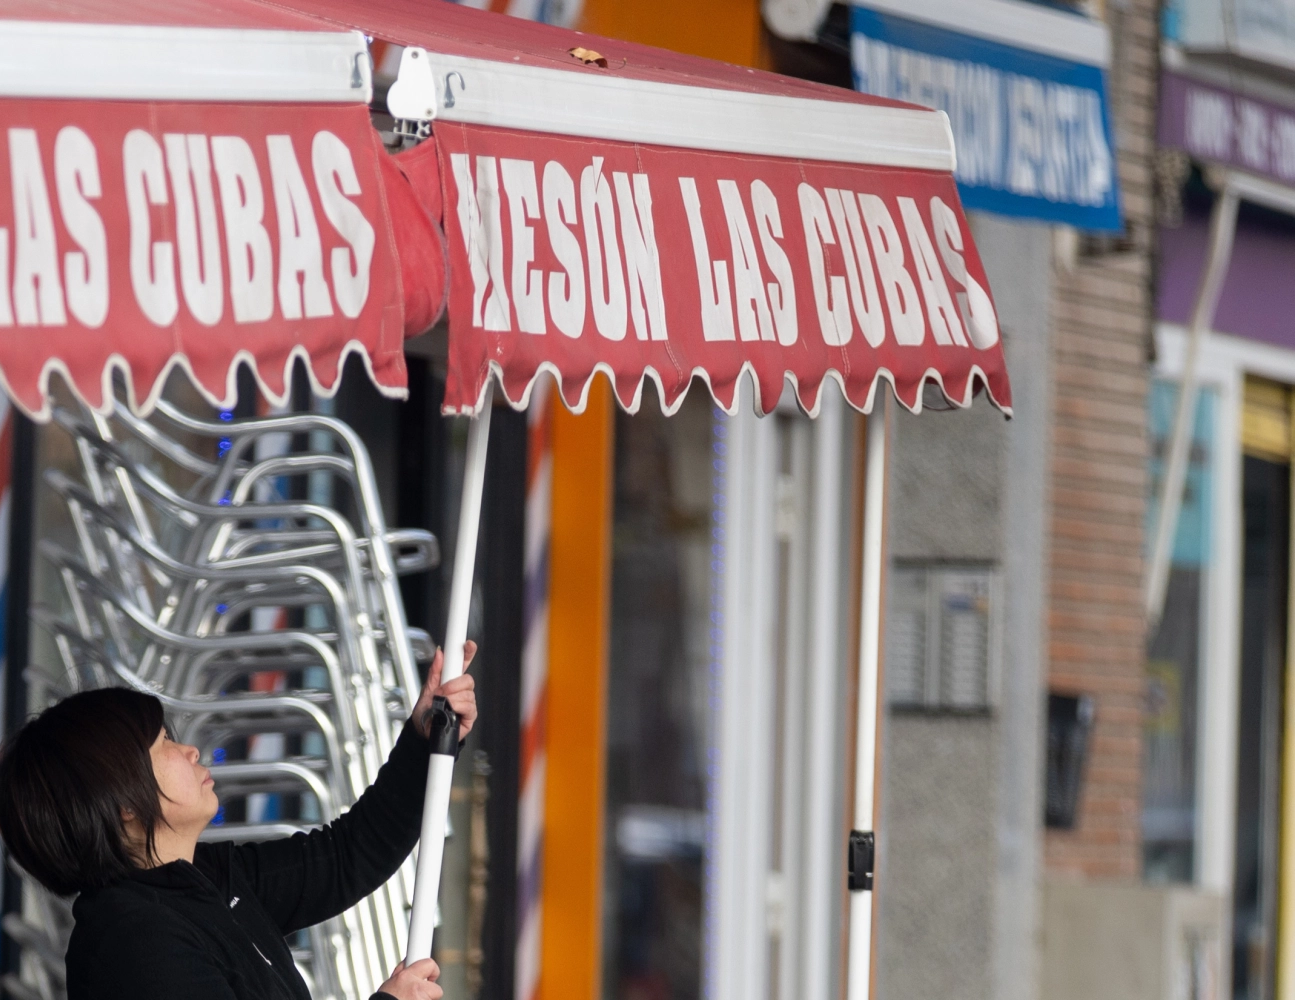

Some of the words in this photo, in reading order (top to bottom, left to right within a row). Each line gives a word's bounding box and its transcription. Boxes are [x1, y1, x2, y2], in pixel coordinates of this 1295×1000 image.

[122, 129, 376, 328] CUBAS
[450, 153, 669, 342] MESÓN
[678, 176, 800, 347] LAS
[797, 182, 999, 351] CUBAS
